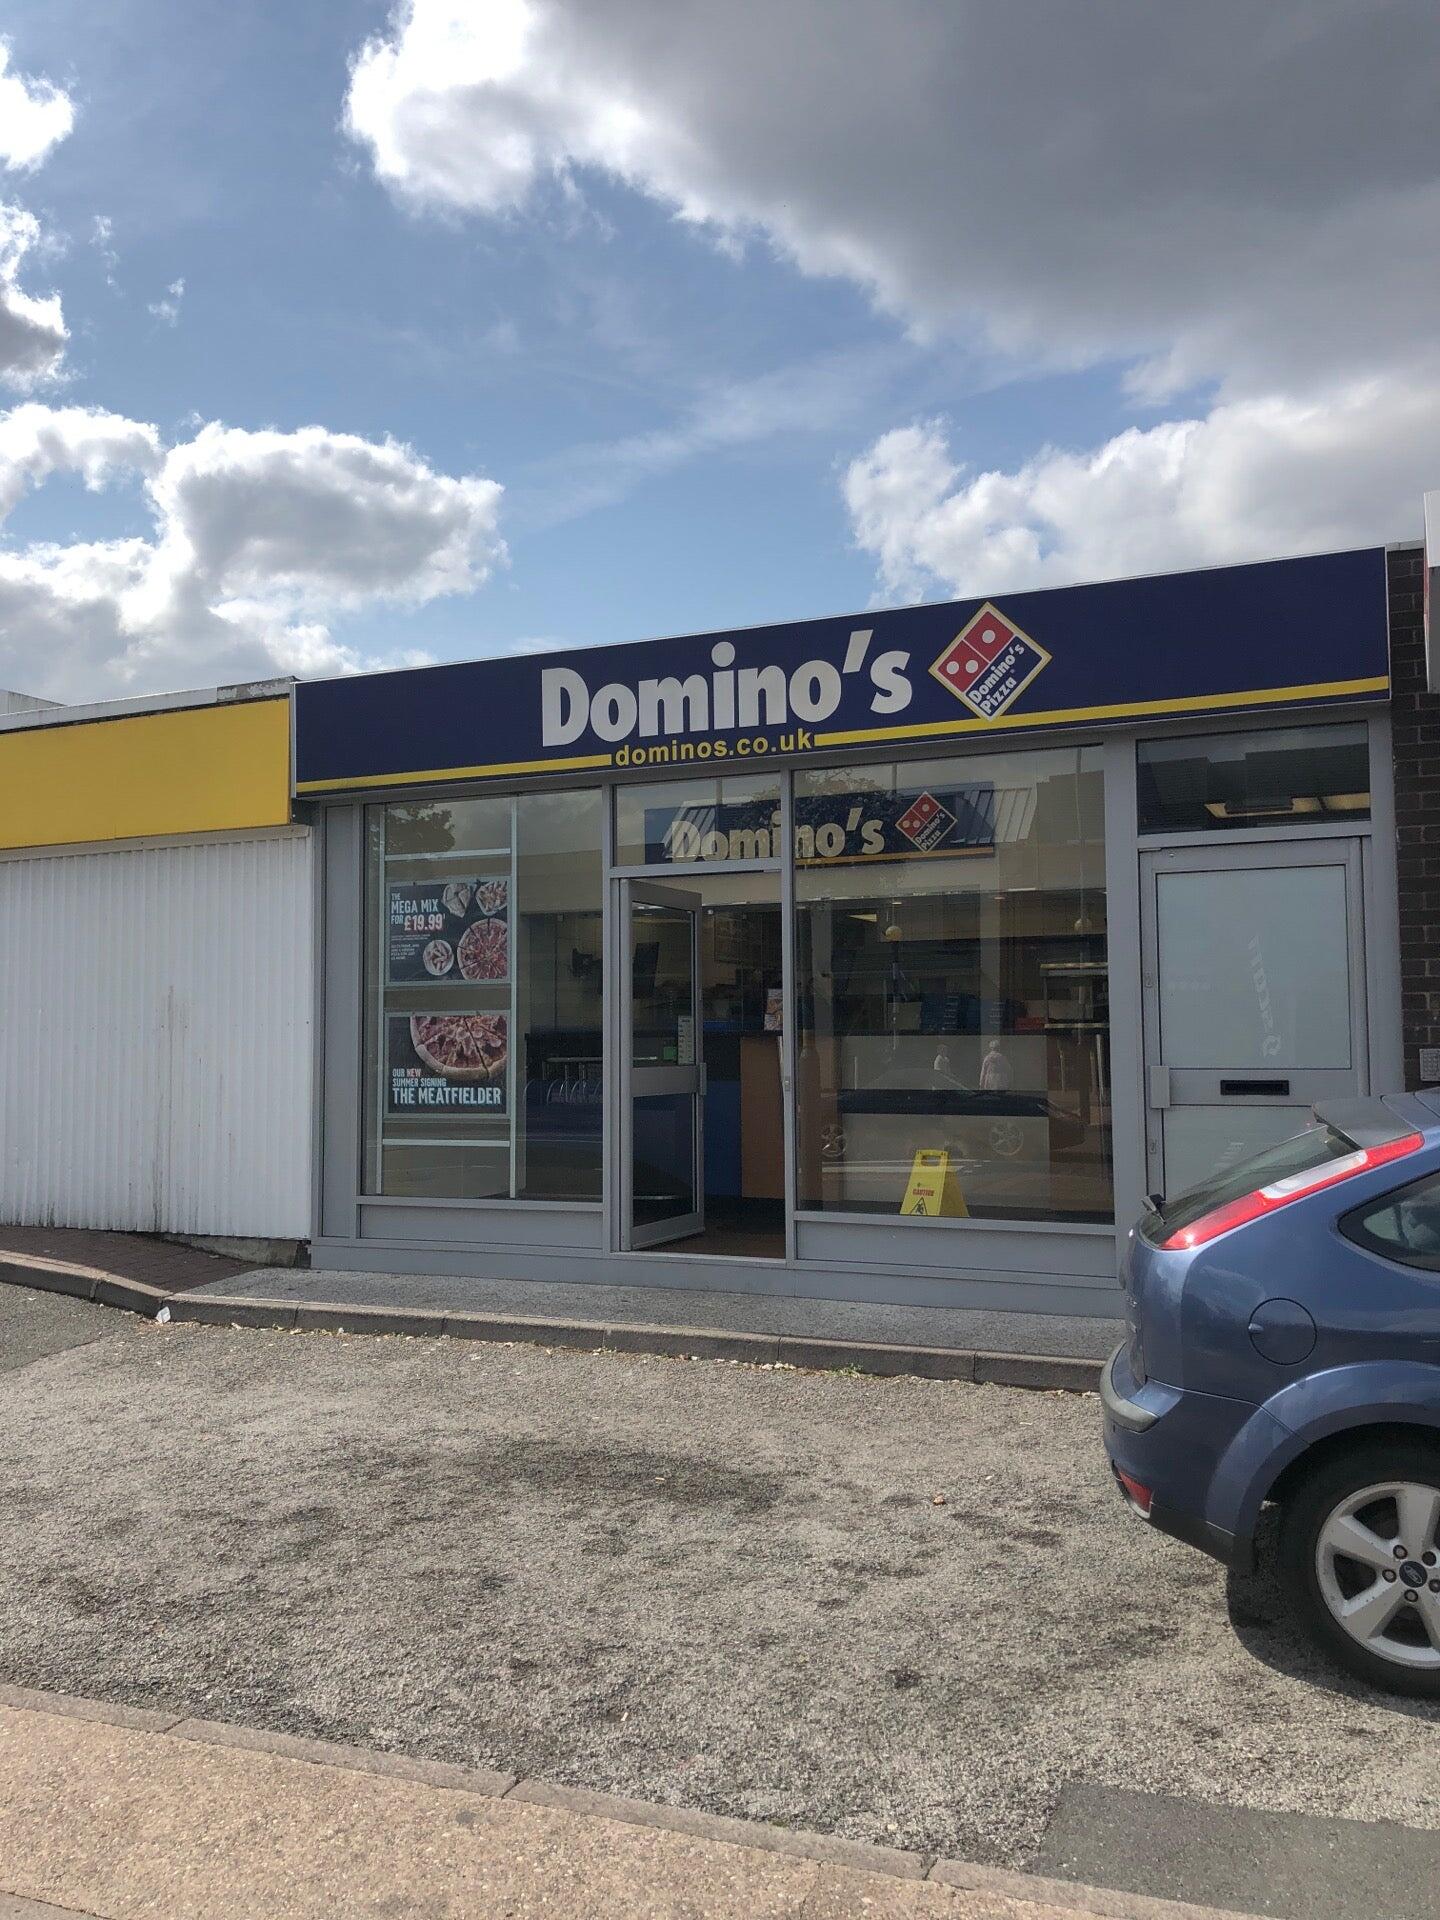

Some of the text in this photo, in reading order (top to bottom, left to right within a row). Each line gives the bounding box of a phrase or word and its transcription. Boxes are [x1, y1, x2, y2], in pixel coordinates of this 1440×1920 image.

[968, 644, 1025, 704] Domino's
[541, 629, 913, 747] Domino's
[980, 676, 1017, 714] Pizza
[614, 729, 813, 766] dominos.co.uk
[914, 812, 945, 844] Domino's
[391, 899, 438, 914] MEGA MIX
[391, 915, 404, 925] FOR
[392, 1068, 421, 1077] OUR NEW
[392, 1077, 447, 1087] SUMMER SIGNING
[392, 1088, 501, 1104] THE MEATFIELDER
